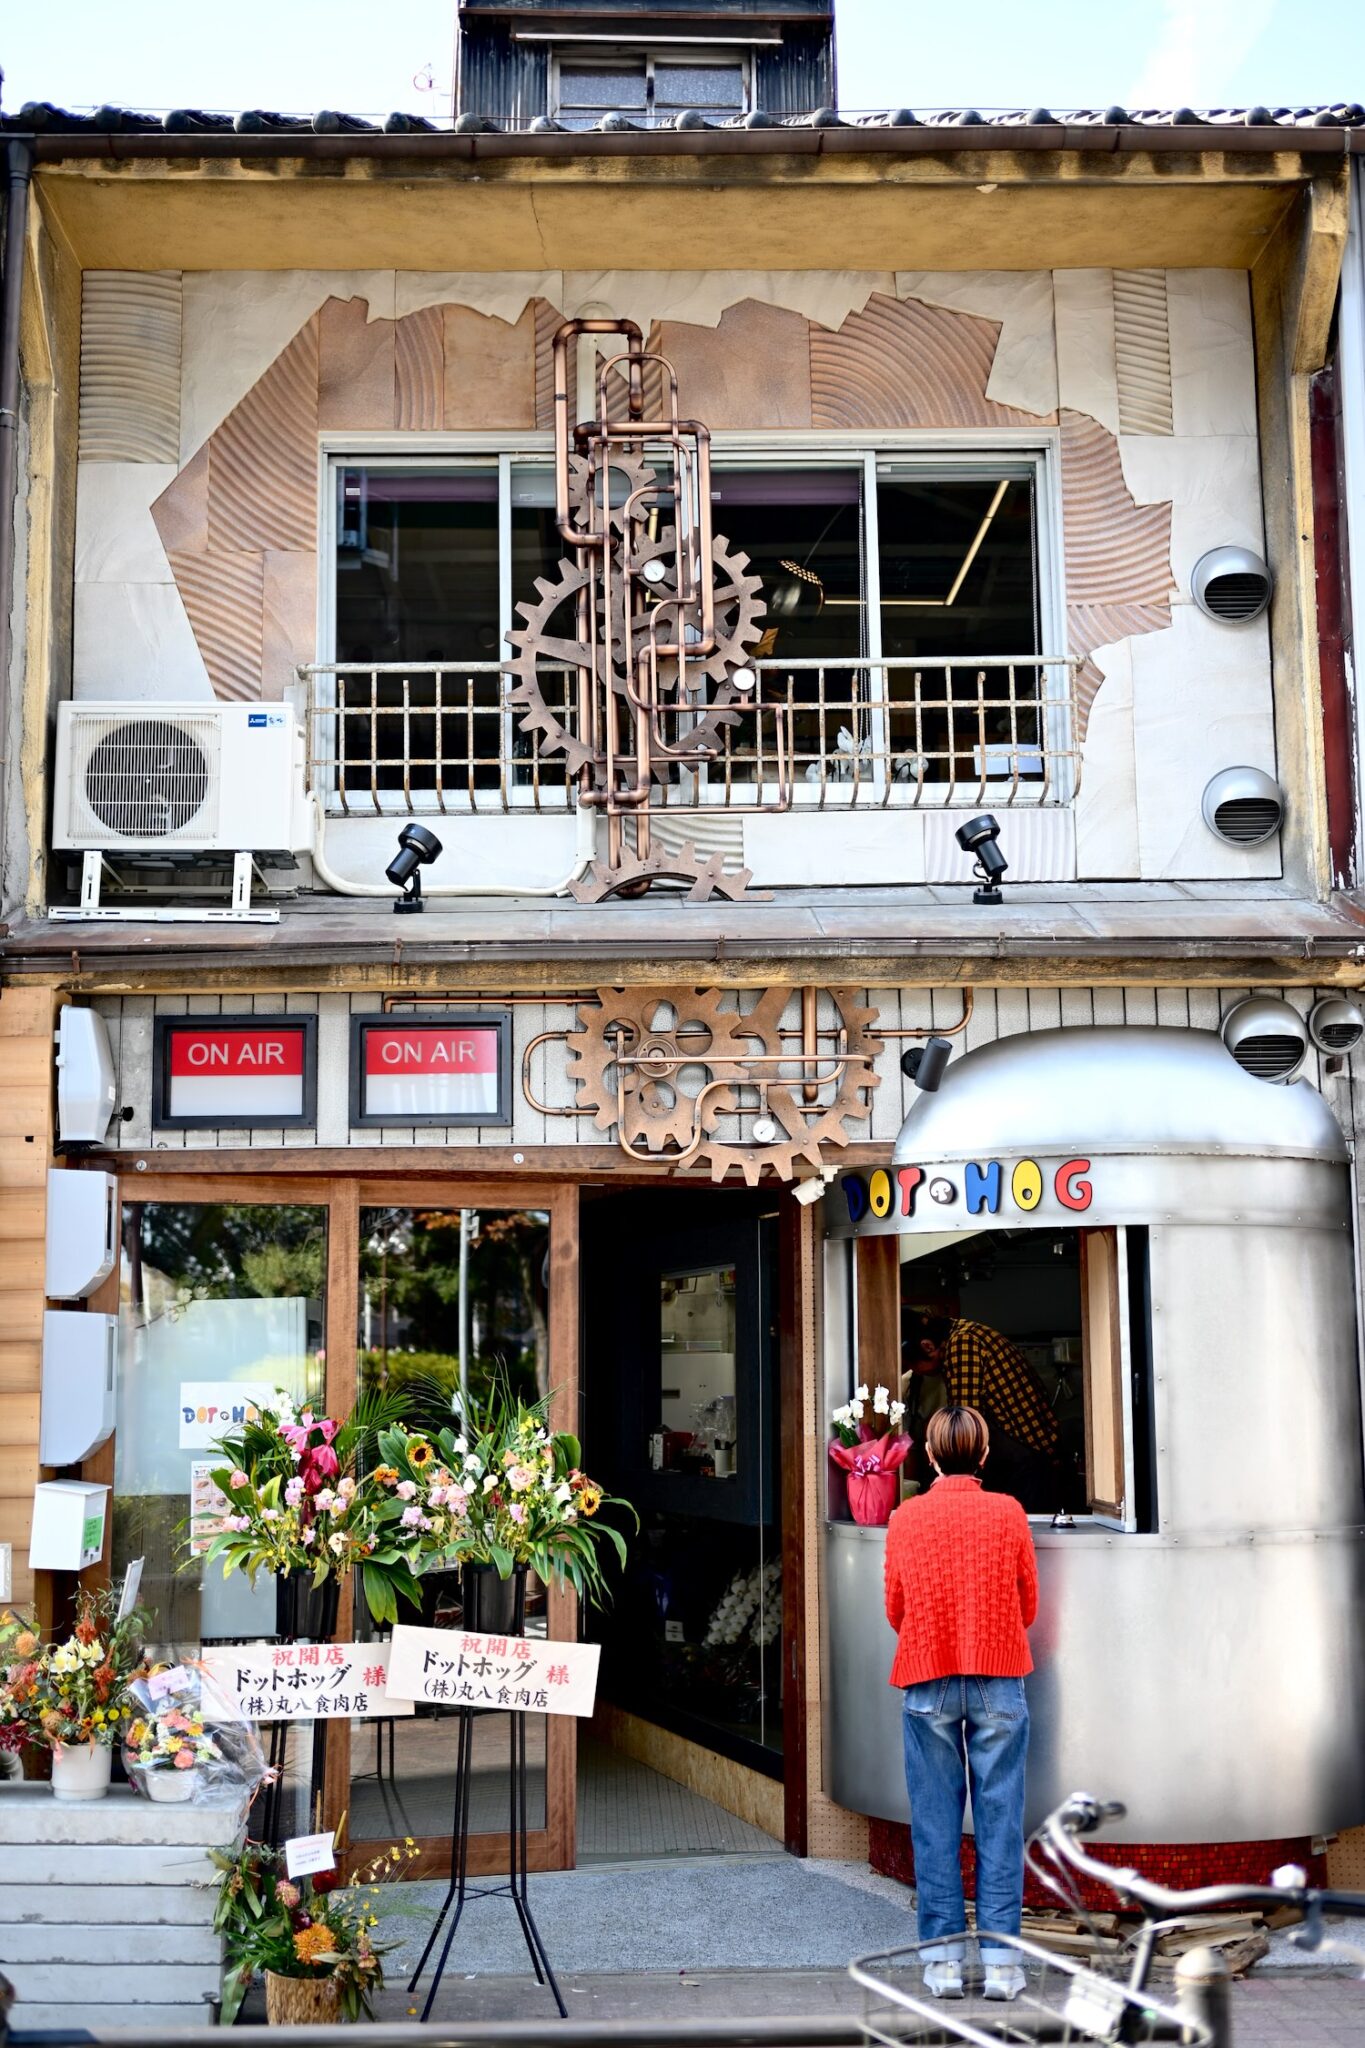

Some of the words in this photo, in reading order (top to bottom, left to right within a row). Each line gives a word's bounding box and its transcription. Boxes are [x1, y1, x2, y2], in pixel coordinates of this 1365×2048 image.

[187, 1042, 229, 1066] ON
[236, 1042, 285, 1065] AIR
[381, 1041, 422, 1064] ON
[430, 1040, 478, 1063] AIR
[841, 1166, 922, 1223] DOT
[964, 1158, 1093, 1215] HOG
[182, 1406, 218, 1424] DOT
[232, 1406, 263, 1424] HO
[272, 1645, 345, 1666] 祝開店
[459, 1634, 532, 1660] 祝開店
[235, 1663, 353, 1692] ドットホッグ
[362, 1664, 387, 1687] 様
[423, 1649, 538, 1683] ドットホッグ
[546, 1664, 570, 1686] 様
[239, 1692, 369, 1716] (株)丸八食肉店
[424, 1677, 550, 1708] (株)丸八食肉店
